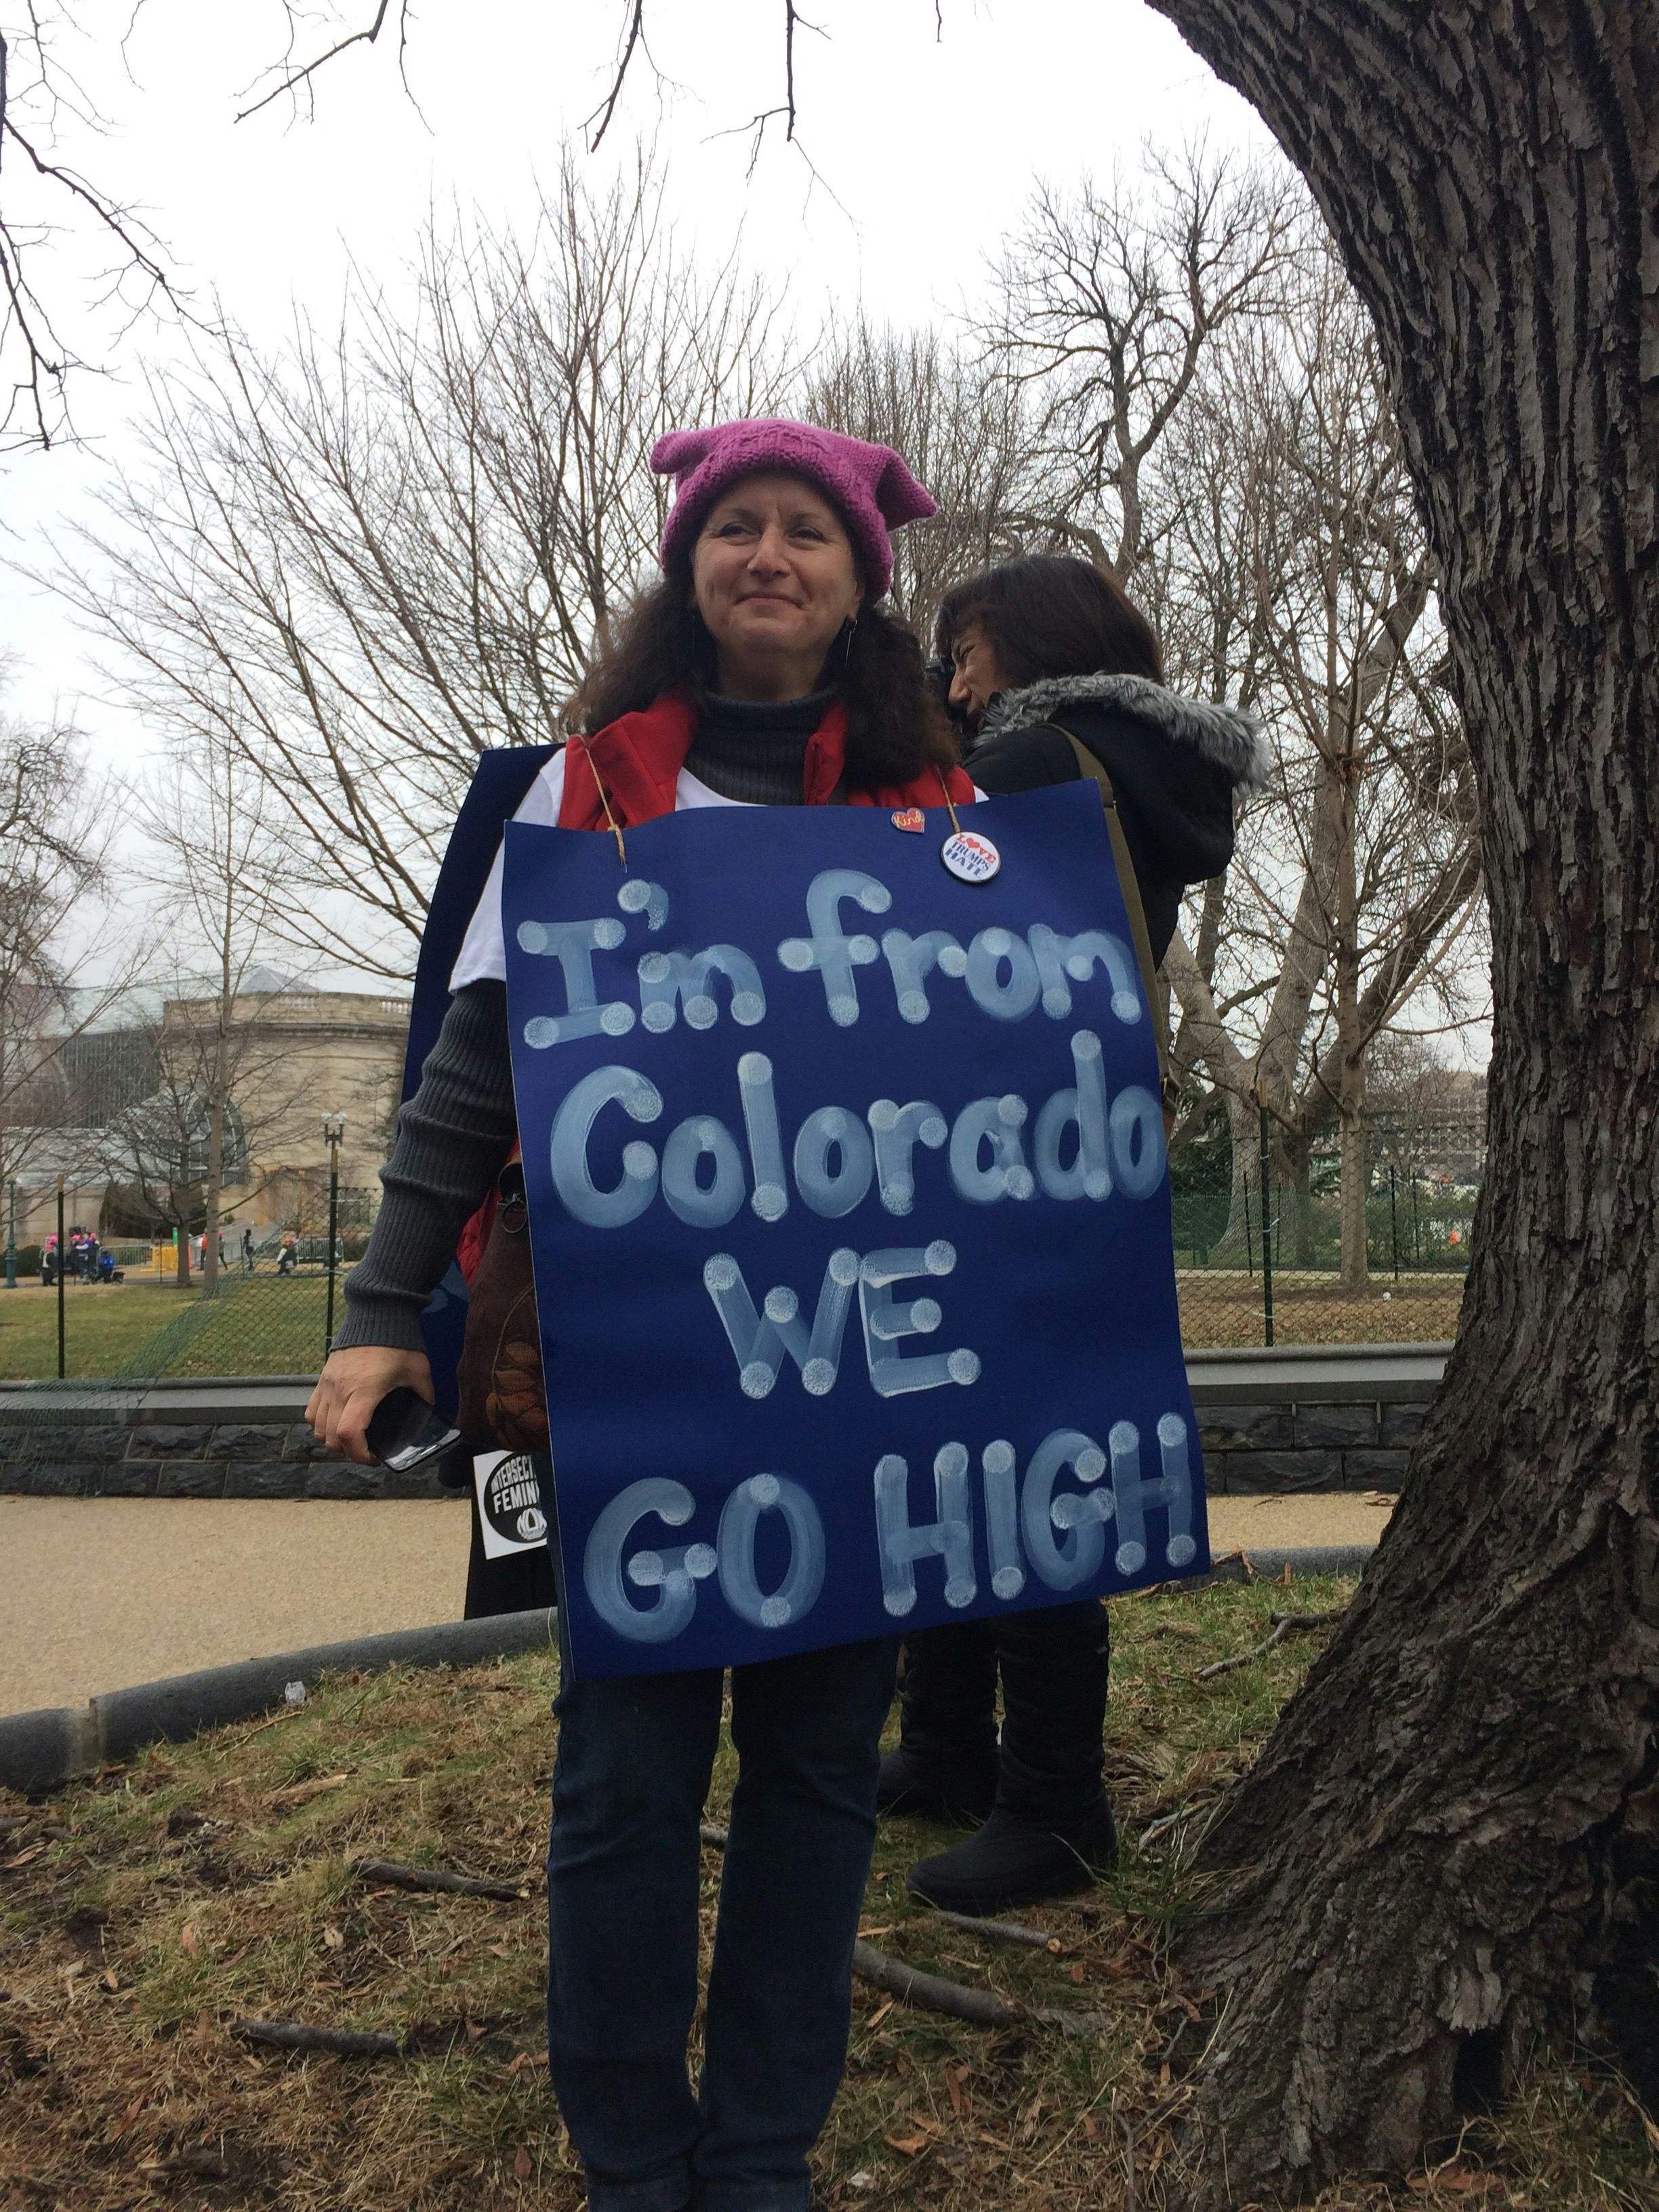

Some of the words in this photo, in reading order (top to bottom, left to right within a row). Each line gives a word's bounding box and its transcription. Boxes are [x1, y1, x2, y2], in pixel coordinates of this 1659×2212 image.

[945, 848, 985, 880] HATE
[951, 841, 990, 871] TRUMPS
[516, 879, 766, 1048] I'm
[777, 869, 1142, 1027] from
[550, 1029, 1166, 1228] Colorado
[703, 1240, 981, 1399] WE
[583, 1473, 826, 1642] GO
[874, 1412, 1196, 1616] HIGH
